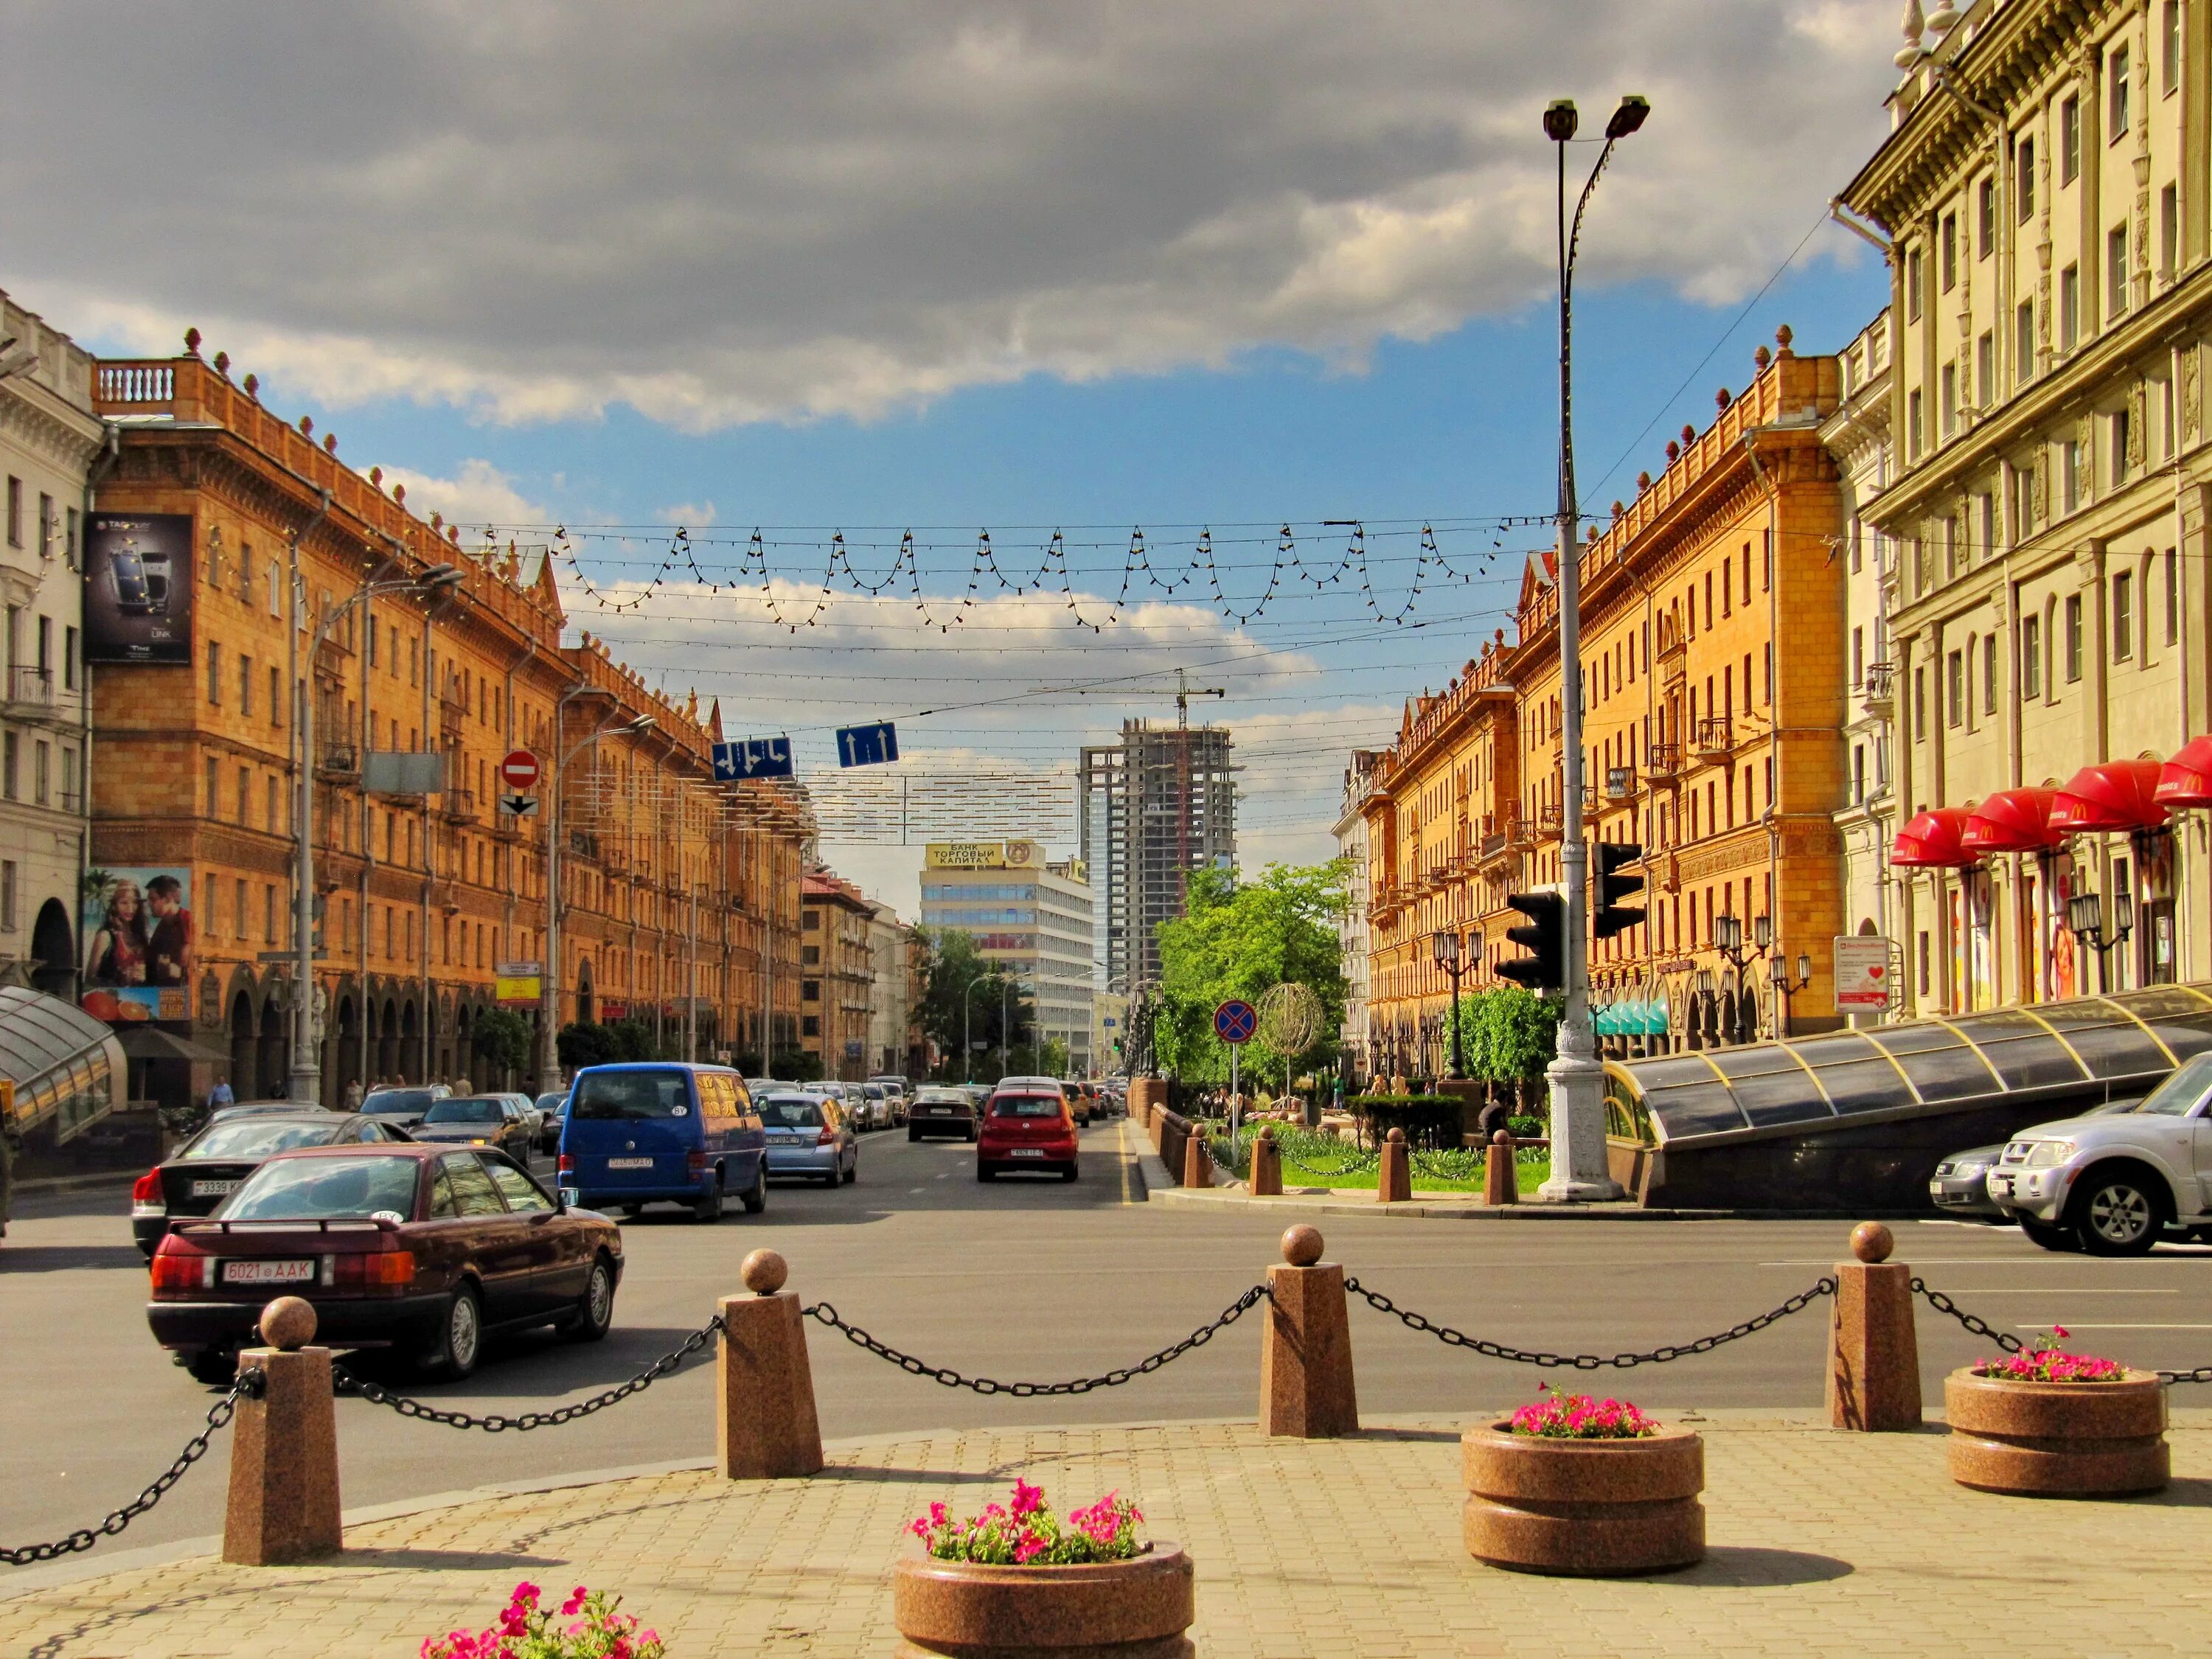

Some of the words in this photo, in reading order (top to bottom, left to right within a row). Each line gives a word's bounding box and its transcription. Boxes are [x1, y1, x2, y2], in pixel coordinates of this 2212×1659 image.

[933, 849, 995, 858] ТОРГОВЫЙ
[204, 1182, 227, 1192] 3339
[229, 1263, 260, 1279] 6021
[274, 1262, 310, 1278] AAK
